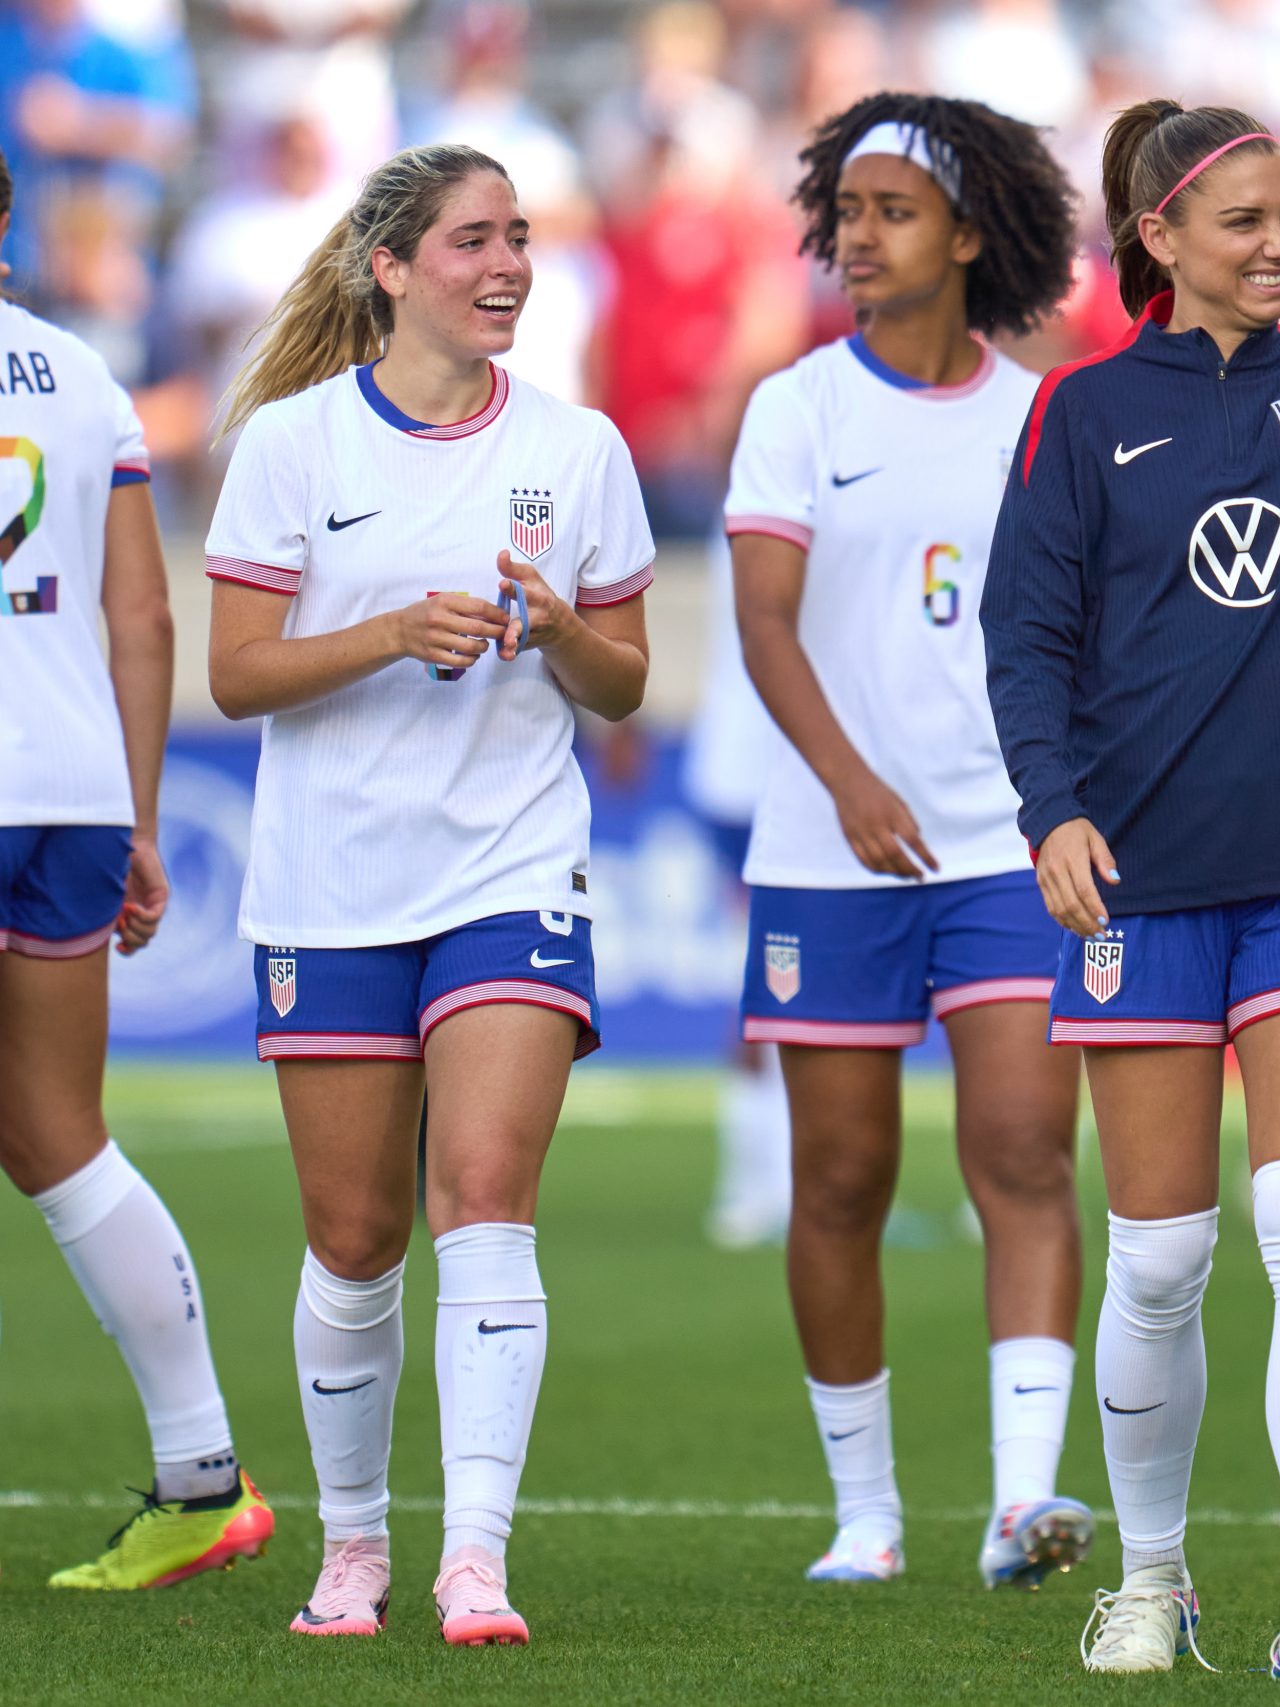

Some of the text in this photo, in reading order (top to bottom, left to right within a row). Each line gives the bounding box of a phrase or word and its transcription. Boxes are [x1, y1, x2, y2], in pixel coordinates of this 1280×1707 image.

[0, 352, 56, 394] AB
[0, 435, 58, 616] 2
[513, 503, 549, 527] USA
[923, 542, 962, 628] 6
[270, 961, 294, 984] USA
[1087, 944, 1121, 968] USA
[172, 1253, 197, 1323] USA
